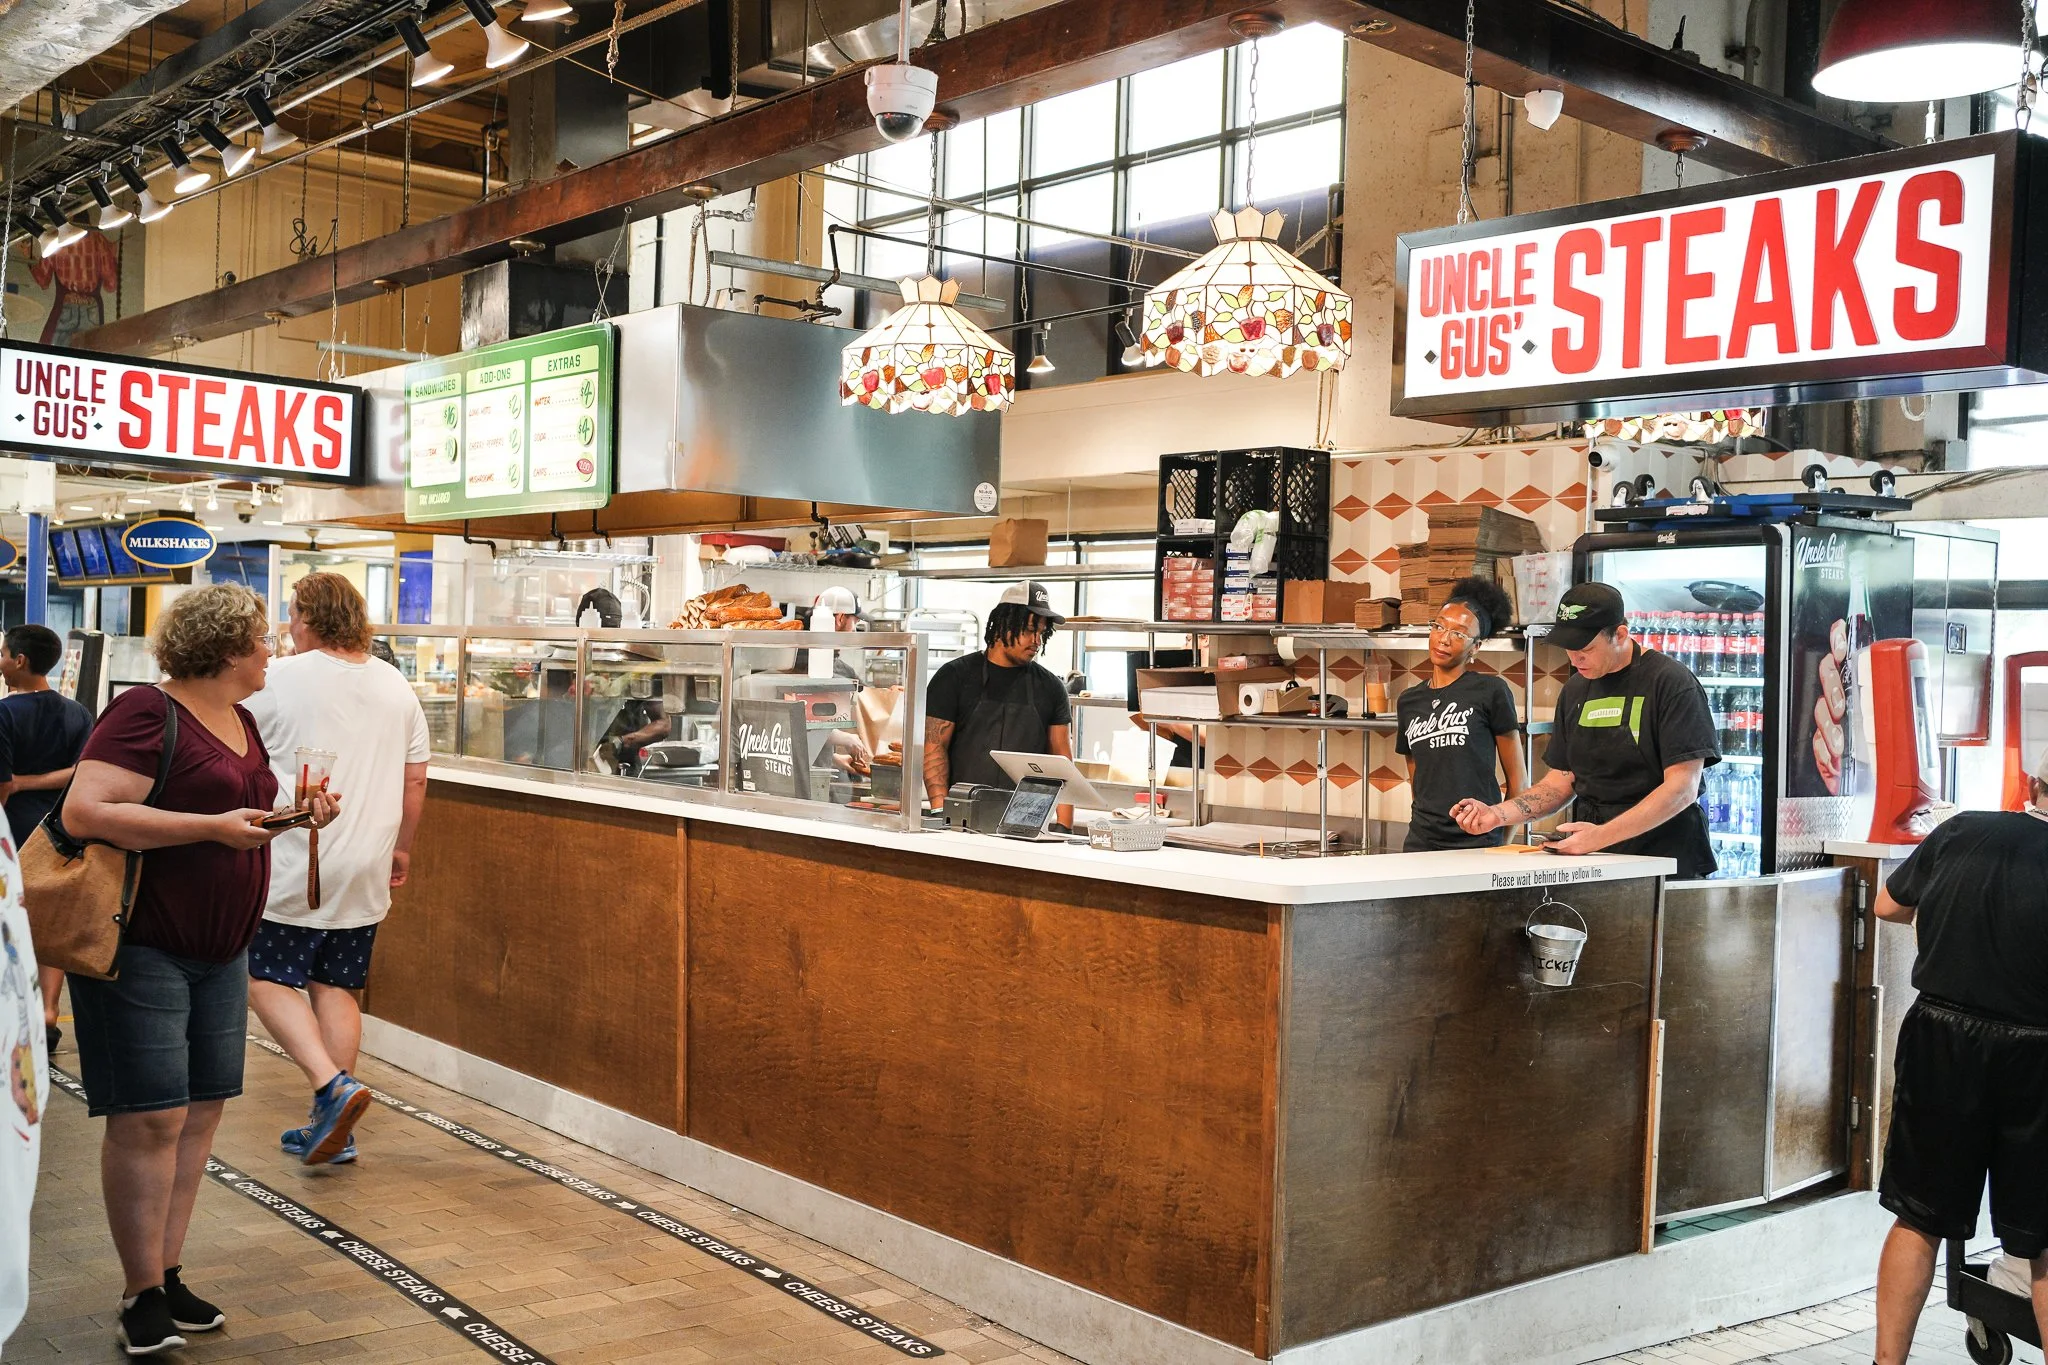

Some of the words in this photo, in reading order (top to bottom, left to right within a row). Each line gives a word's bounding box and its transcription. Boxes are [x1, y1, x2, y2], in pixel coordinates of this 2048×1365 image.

[1420, 242, 1538, 318] UNCLE
[1551, 169, 1965, 375] STEAKS
[548, 354, 581, 372] EXTRAS
[1440, 312, 1524, 380] GUS'
[16, 358, 107, 404] UNCLE
[415, 379, 456, 398] SANDWICHES
[479, 368, 511, 384] ADD-ONS
[33, 400, 96, 440] GUS'
[118, 370, 344, 470] STEAKS
[129, 537, 211, 549] MILKSHAKES
[1796, 536, 1826, 572] Uncle
[1820, 567, 1845, 580] STEAKS
[739, 723, 770, 760] Uncle
[1429, 734, 1466, 749] STEAKS
[765, 759, 792, 777] STEAKS
[1491, 873, 1515, 888] Please
[1516, 873, 1531, 886] wait
[1533, 870, 1557, 884] behind
[1558, 869, 1569, 882] the
[1571, 867, 1590, 882] yellow
[415, 1112, 462, 1131] CHEESE
[453, 1129, 501, 1149] STEAKS
[517, 1158, 571, 1179] CHEESE
[562, 1177, 617, 1200] STEAKS
[234, 1182, 284, 1205] CHEESE
[273, 1202, 325, 1229] STEAKS
[636, 1211, 700, 1238] CHEESE
[690, 1236, 756, 1266] STEAKS
[338, 1240, 397, 1271] CHEESE
[383, 1269, 445, 1303] STEAKS
[783, 1281, 860, 1319] CHEESE
[851, 1316, 931, 1355] STEAKS
[463, 1322, 535, 1363] CHEESE
